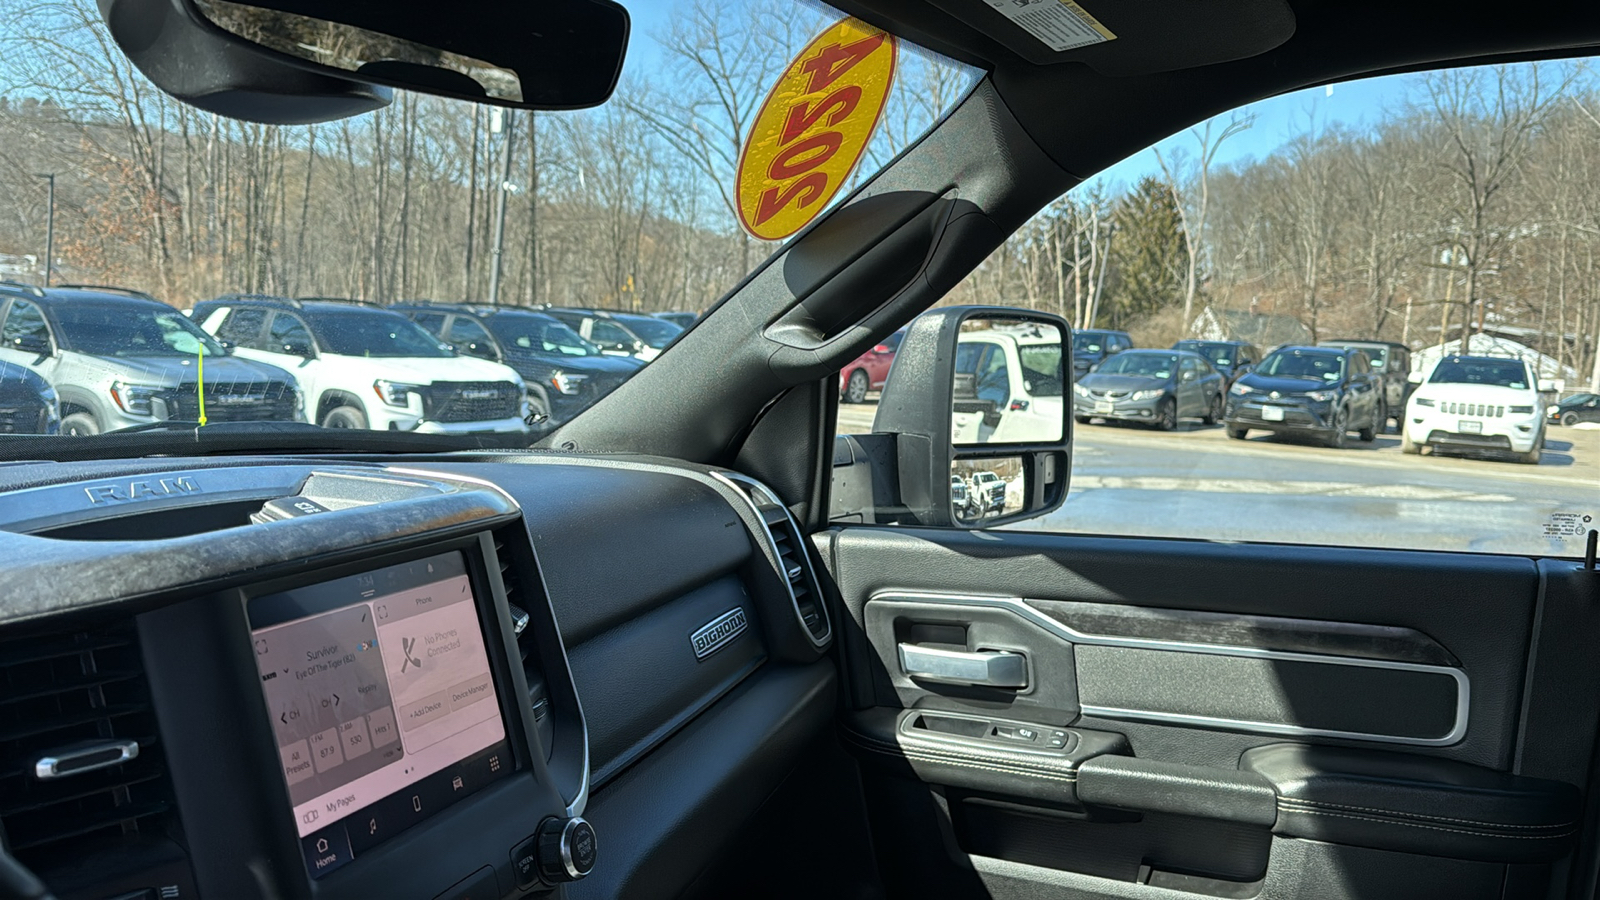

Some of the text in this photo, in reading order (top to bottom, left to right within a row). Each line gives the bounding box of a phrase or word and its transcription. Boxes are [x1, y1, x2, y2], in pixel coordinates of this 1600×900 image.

[84, 475, 202, 504] RAM
[415, 595, 433, 606] Phone
[424, 629, 458, 646] No Phones
[694, 611, 746, 653] BIGHORN
[306, 645, 339, 662] Survivor
[427, 638, 461, 658] Connected
[295, 670, 308, 681] Eye
[307, 665, 316, 676] Of
[316, 663, 328, 672] The
[327, 659, 343, 670] Tiger
[357, 684, 377, 695] Replay
[452, 682, 490, 702] Device Manager
[289, 708, 301, 720] CH
[413, 701, 442, 719] Add Device
[350, 734, 363, 746] 530
[291, 751, 301, 761] All
[286, 760, 311, 776] Presets
[326, 794, 356, 813] My Pages
[315, 853, 337, 870] Home
